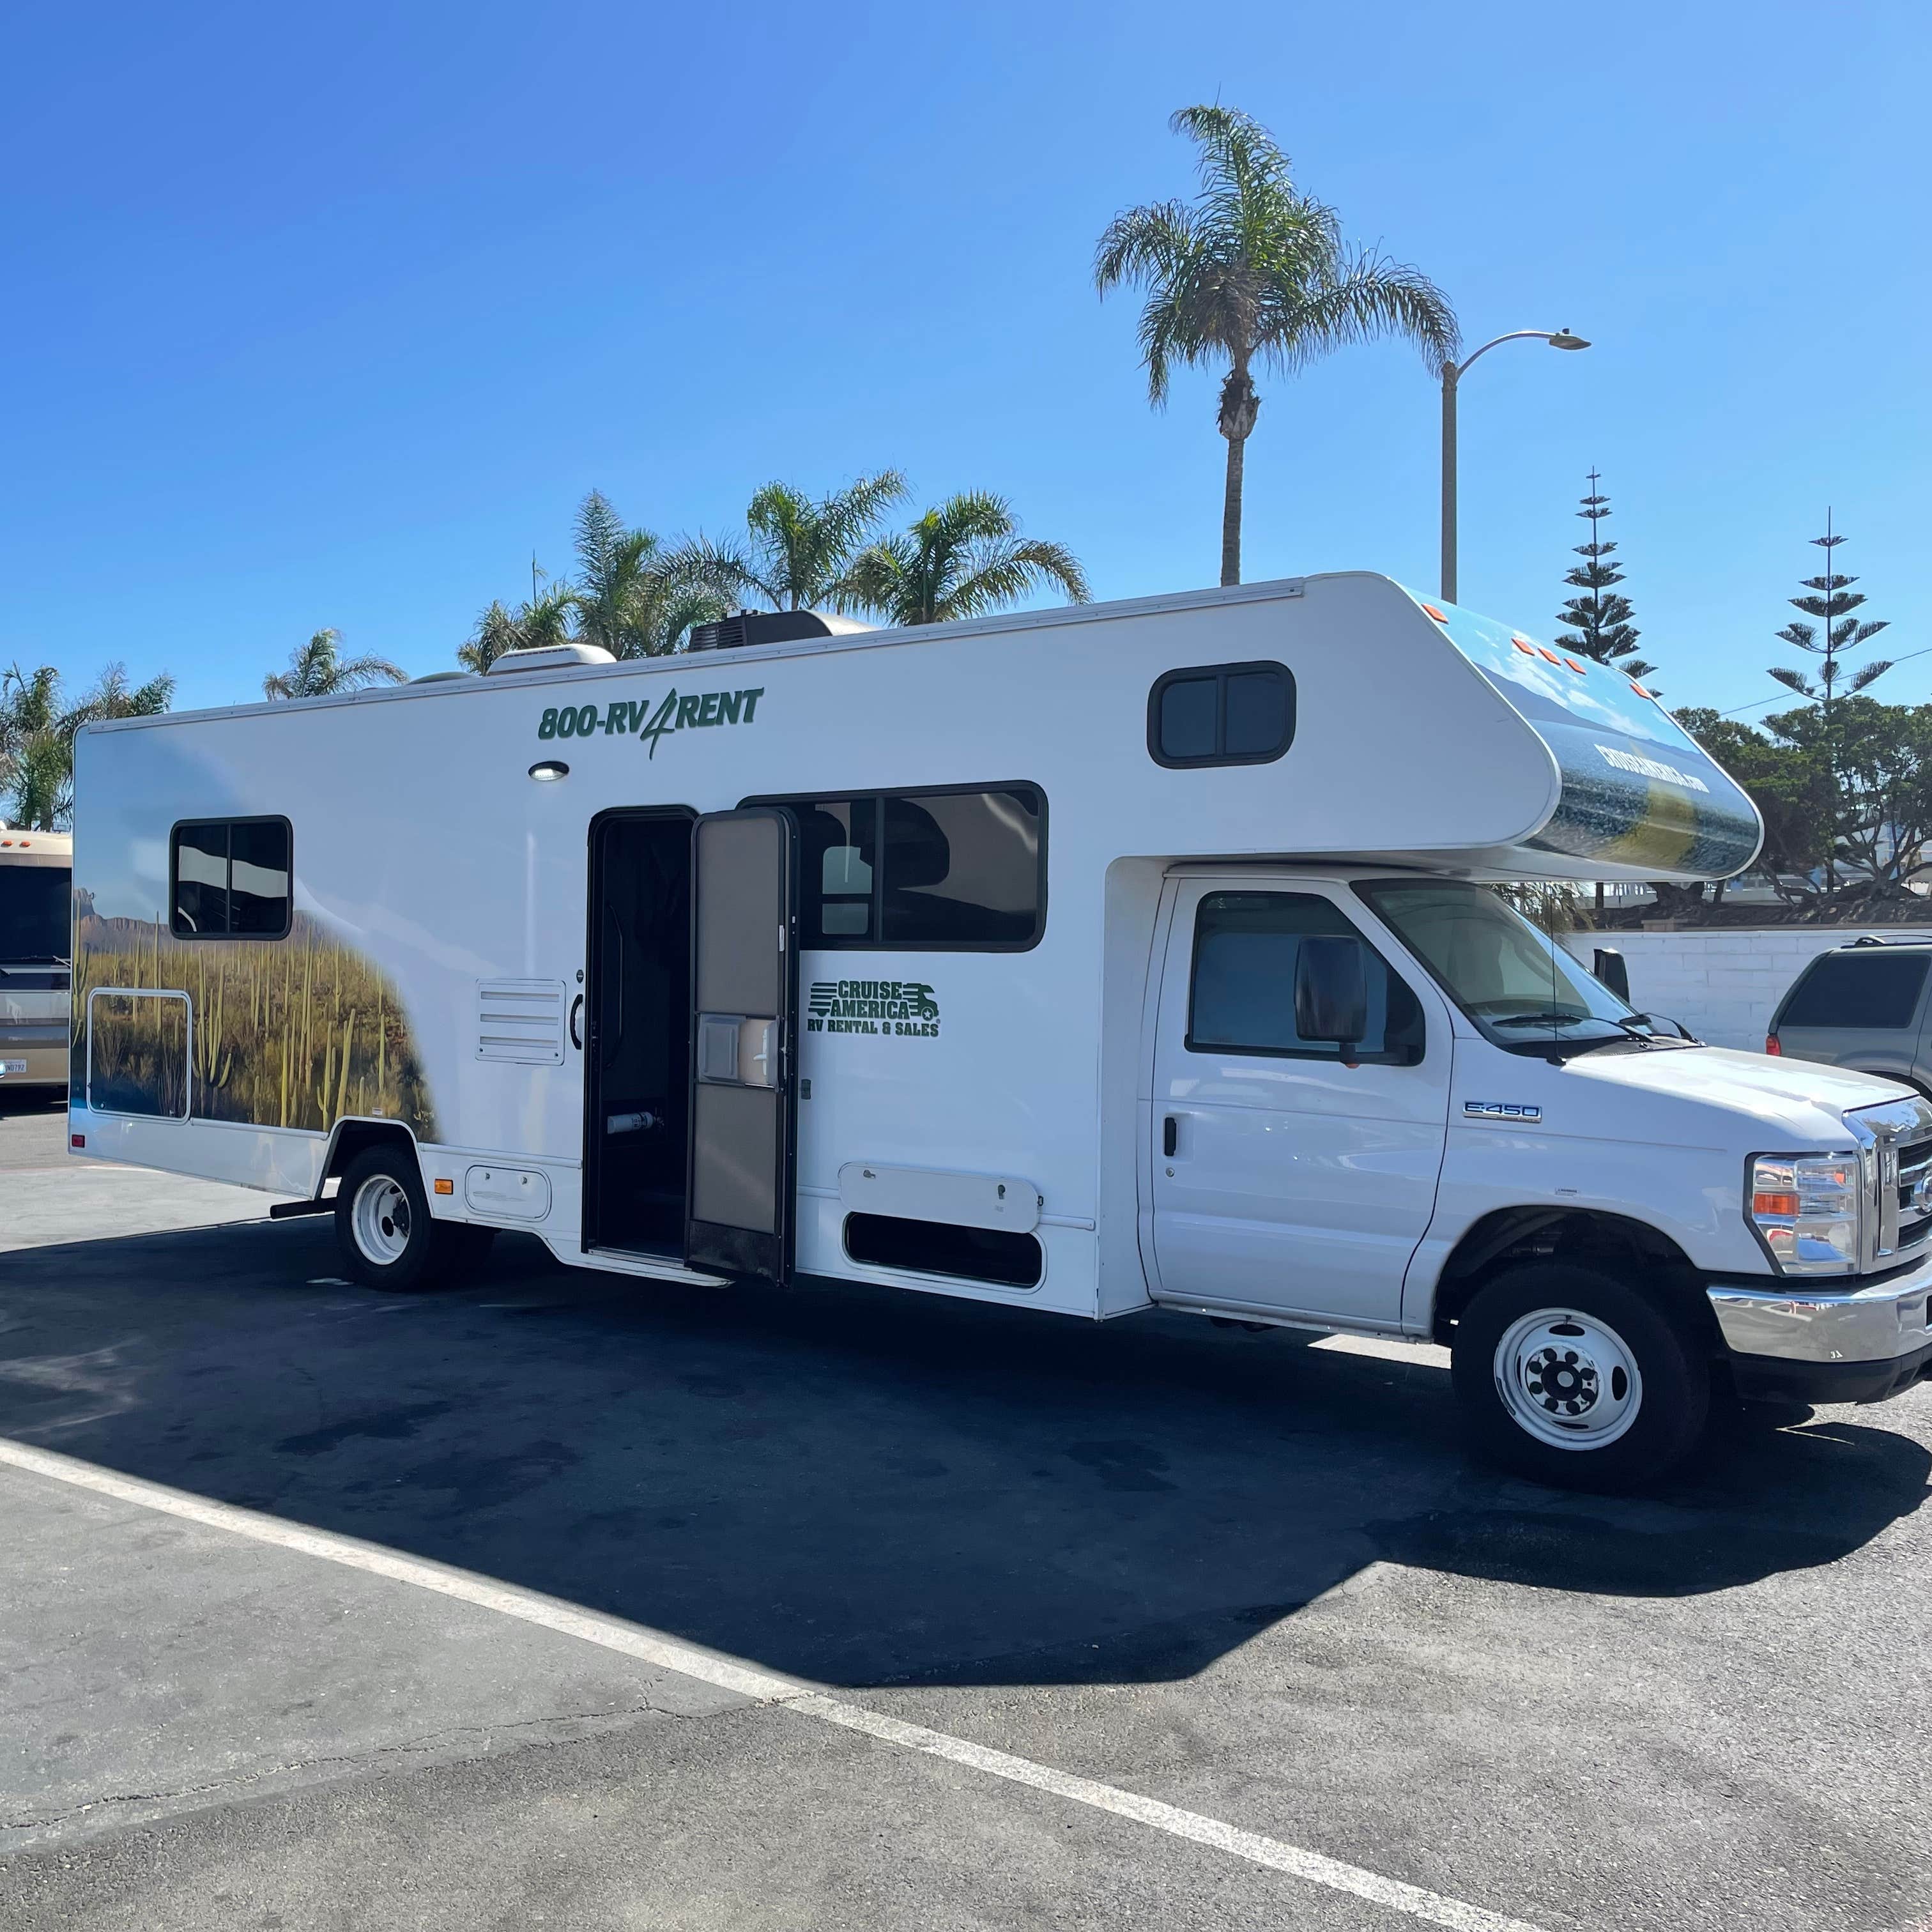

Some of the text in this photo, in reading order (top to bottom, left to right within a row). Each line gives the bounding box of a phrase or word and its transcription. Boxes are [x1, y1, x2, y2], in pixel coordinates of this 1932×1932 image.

[838, 980, 903, 1000] CRUISE
[830, 999, 910, 1020] AMERICA
[807, 1018, 939, 1038] RV RENTAL & SALES
[1465, 1102, 1540, 1117] E-450
